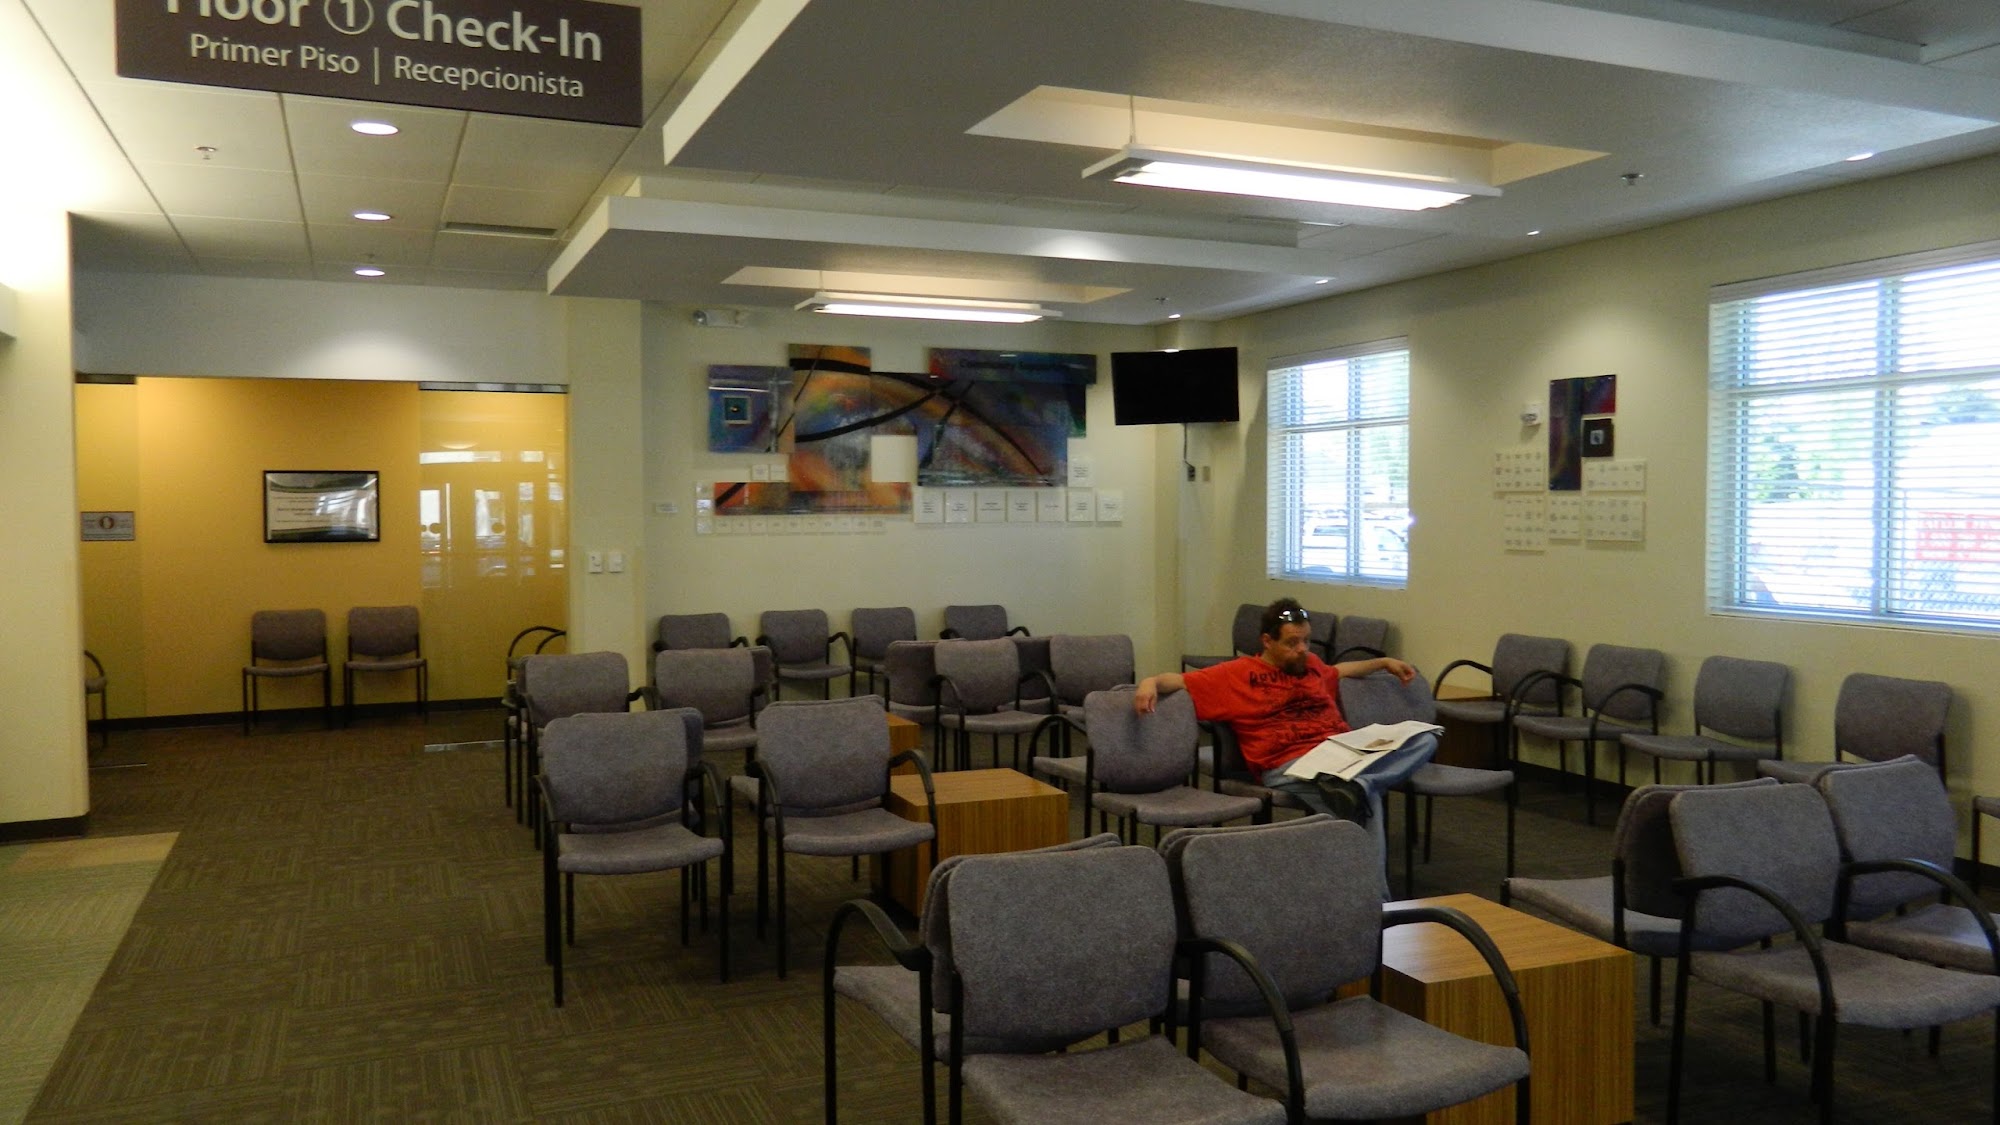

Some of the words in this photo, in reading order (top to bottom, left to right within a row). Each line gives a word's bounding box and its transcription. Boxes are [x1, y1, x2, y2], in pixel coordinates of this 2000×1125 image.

[166, 0, 310, 28] oor
[386, 0, 602, 63] Check-In
[190, 32, 293, 68] Primer
[300, 44, 360, 75] Piso
[394, 55, 584, 98] Recepcionista
